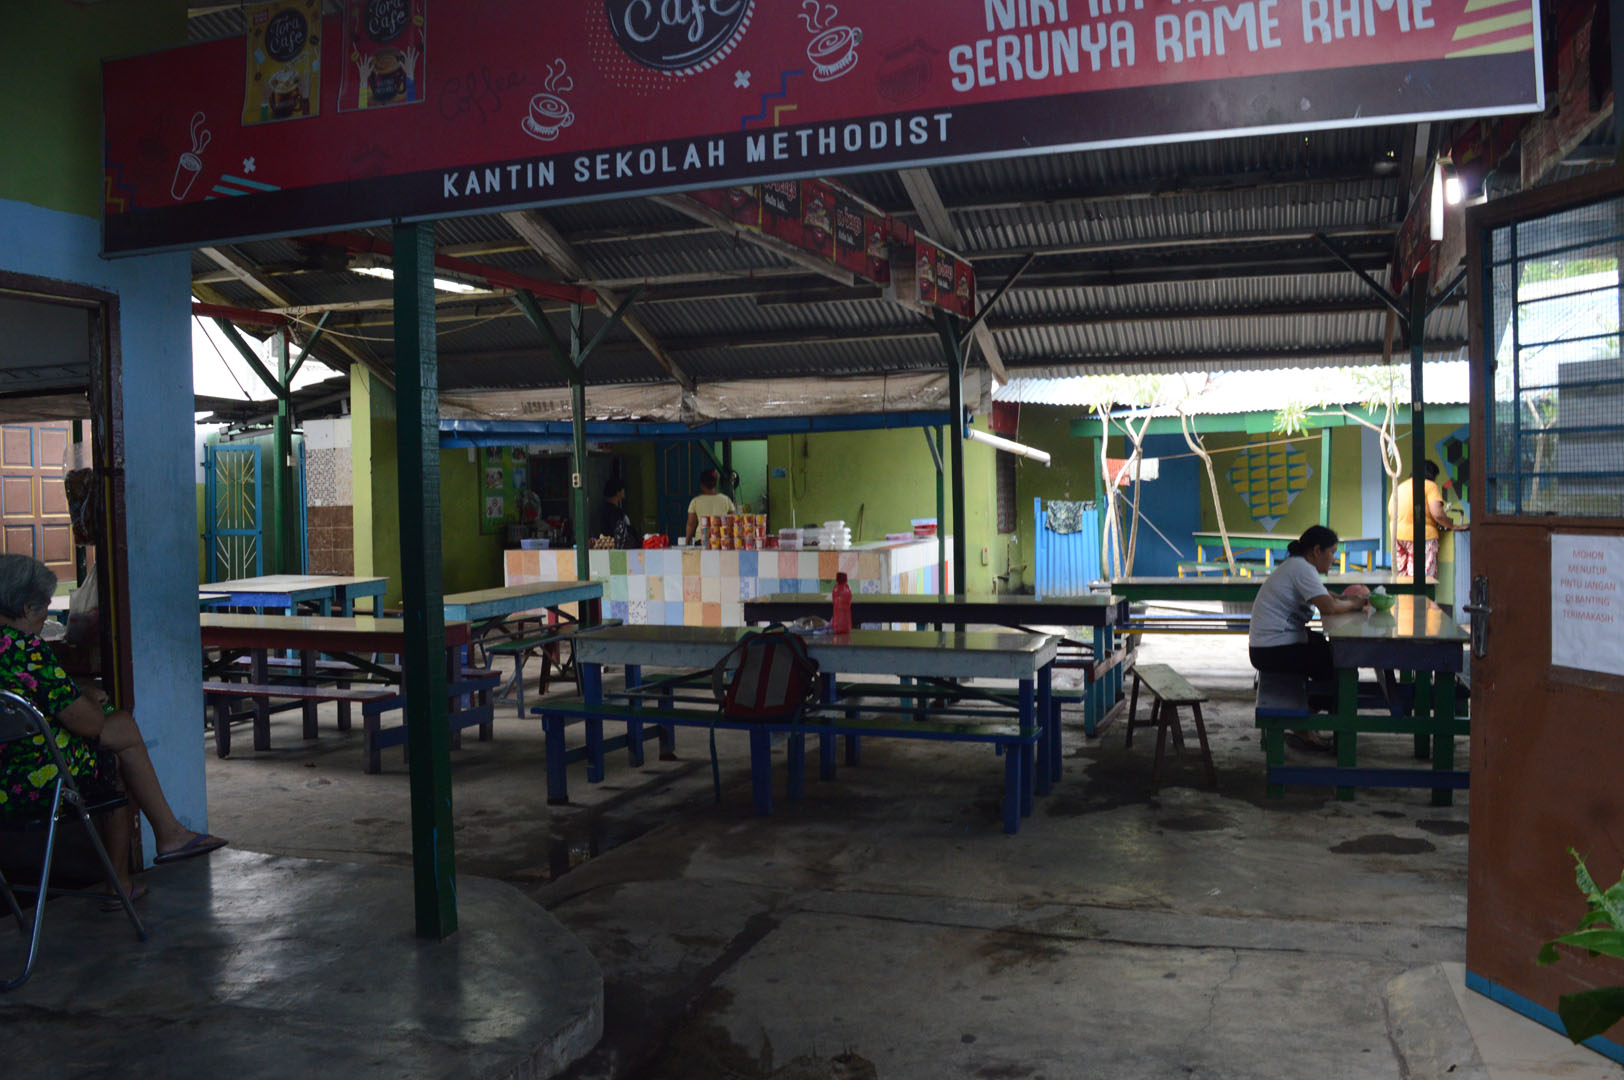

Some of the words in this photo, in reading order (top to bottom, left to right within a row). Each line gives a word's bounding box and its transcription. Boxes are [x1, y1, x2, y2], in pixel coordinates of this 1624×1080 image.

[270, 16, 299, 38] Tora
[369, 9, 405, 34] Cafe
[270, 31, 303, 54] Cafe
[949, 21, 1135, 92] SERUNYA
[1156, 0, 1281, 63] RAME
[1302, 0, 1435, 44] RAME
[443, 161, 559, 199] KANTIN
[573, 138, 727, 184] SEKOLAH
[744, 112, 953, 164] METHODIST
[1572, 549, 1604, 560] MOHON
[1568, 564, 1608, 576] MENUTUP
[1560, 577, 1583, 589] PINTU
[1584, 579, 1616, 592] JANGAN
[1575, 594, 1610, 607] BANTING
[1562, 609, 1614, 623] TERIMAKASIH
